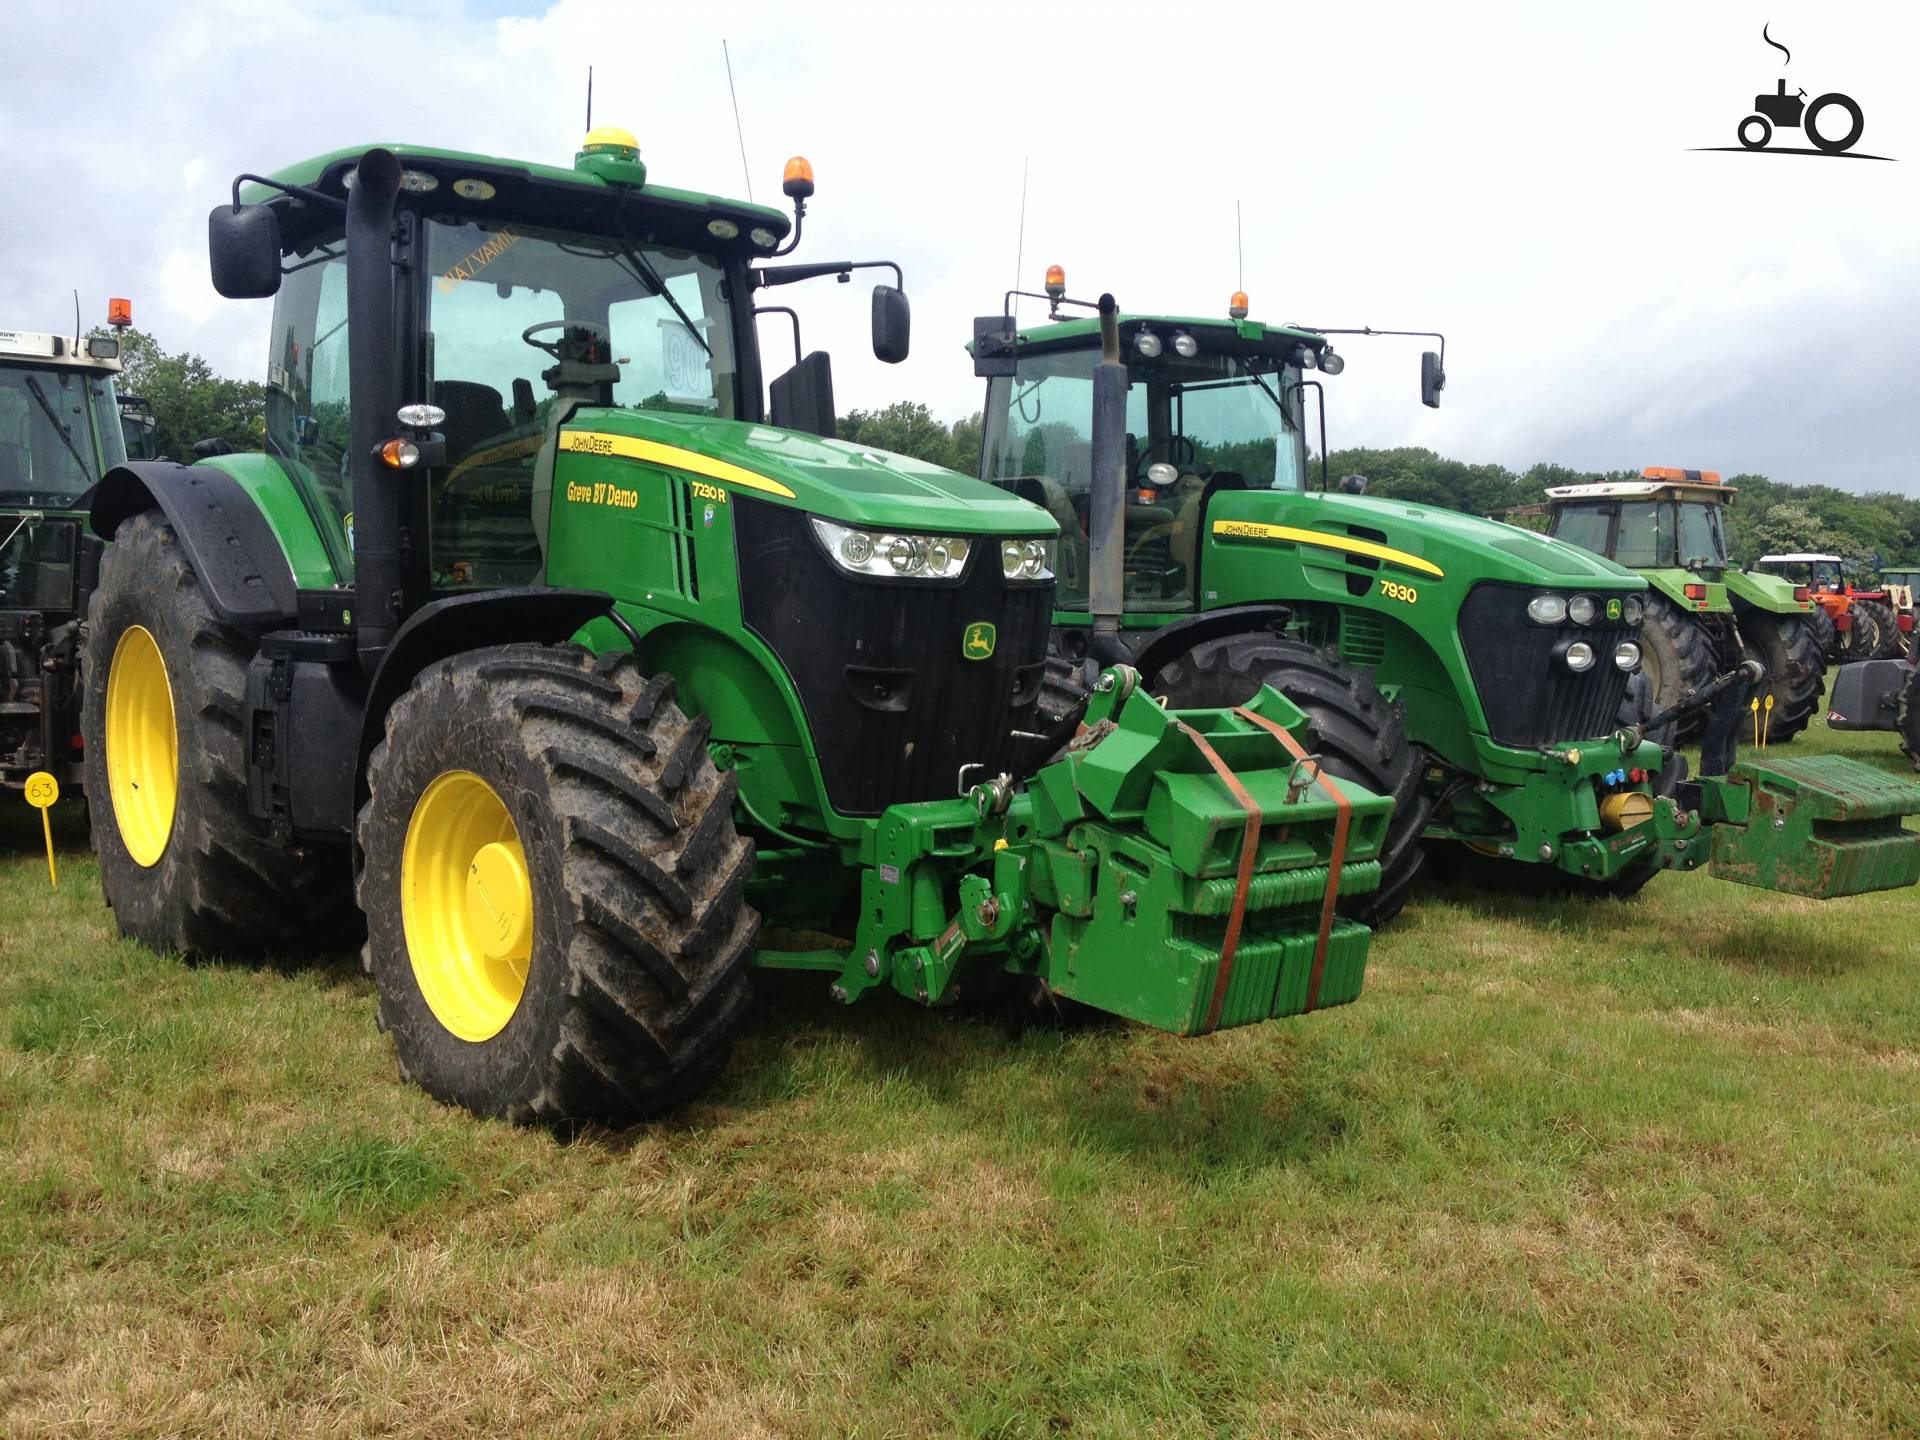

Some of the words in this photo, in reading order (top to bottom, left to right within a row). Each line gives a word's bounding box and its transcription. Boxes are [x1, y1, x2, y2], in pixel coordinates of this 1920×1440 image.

[668, 334, 701, 391] 90
[567, 480, 592, 503] Greve
[592, 482, 607, 504] BV
[606, 484, 638, 508] Demo
[1380, 579, 1417, 603] 7930
[31, 783, 53, 798] 63
